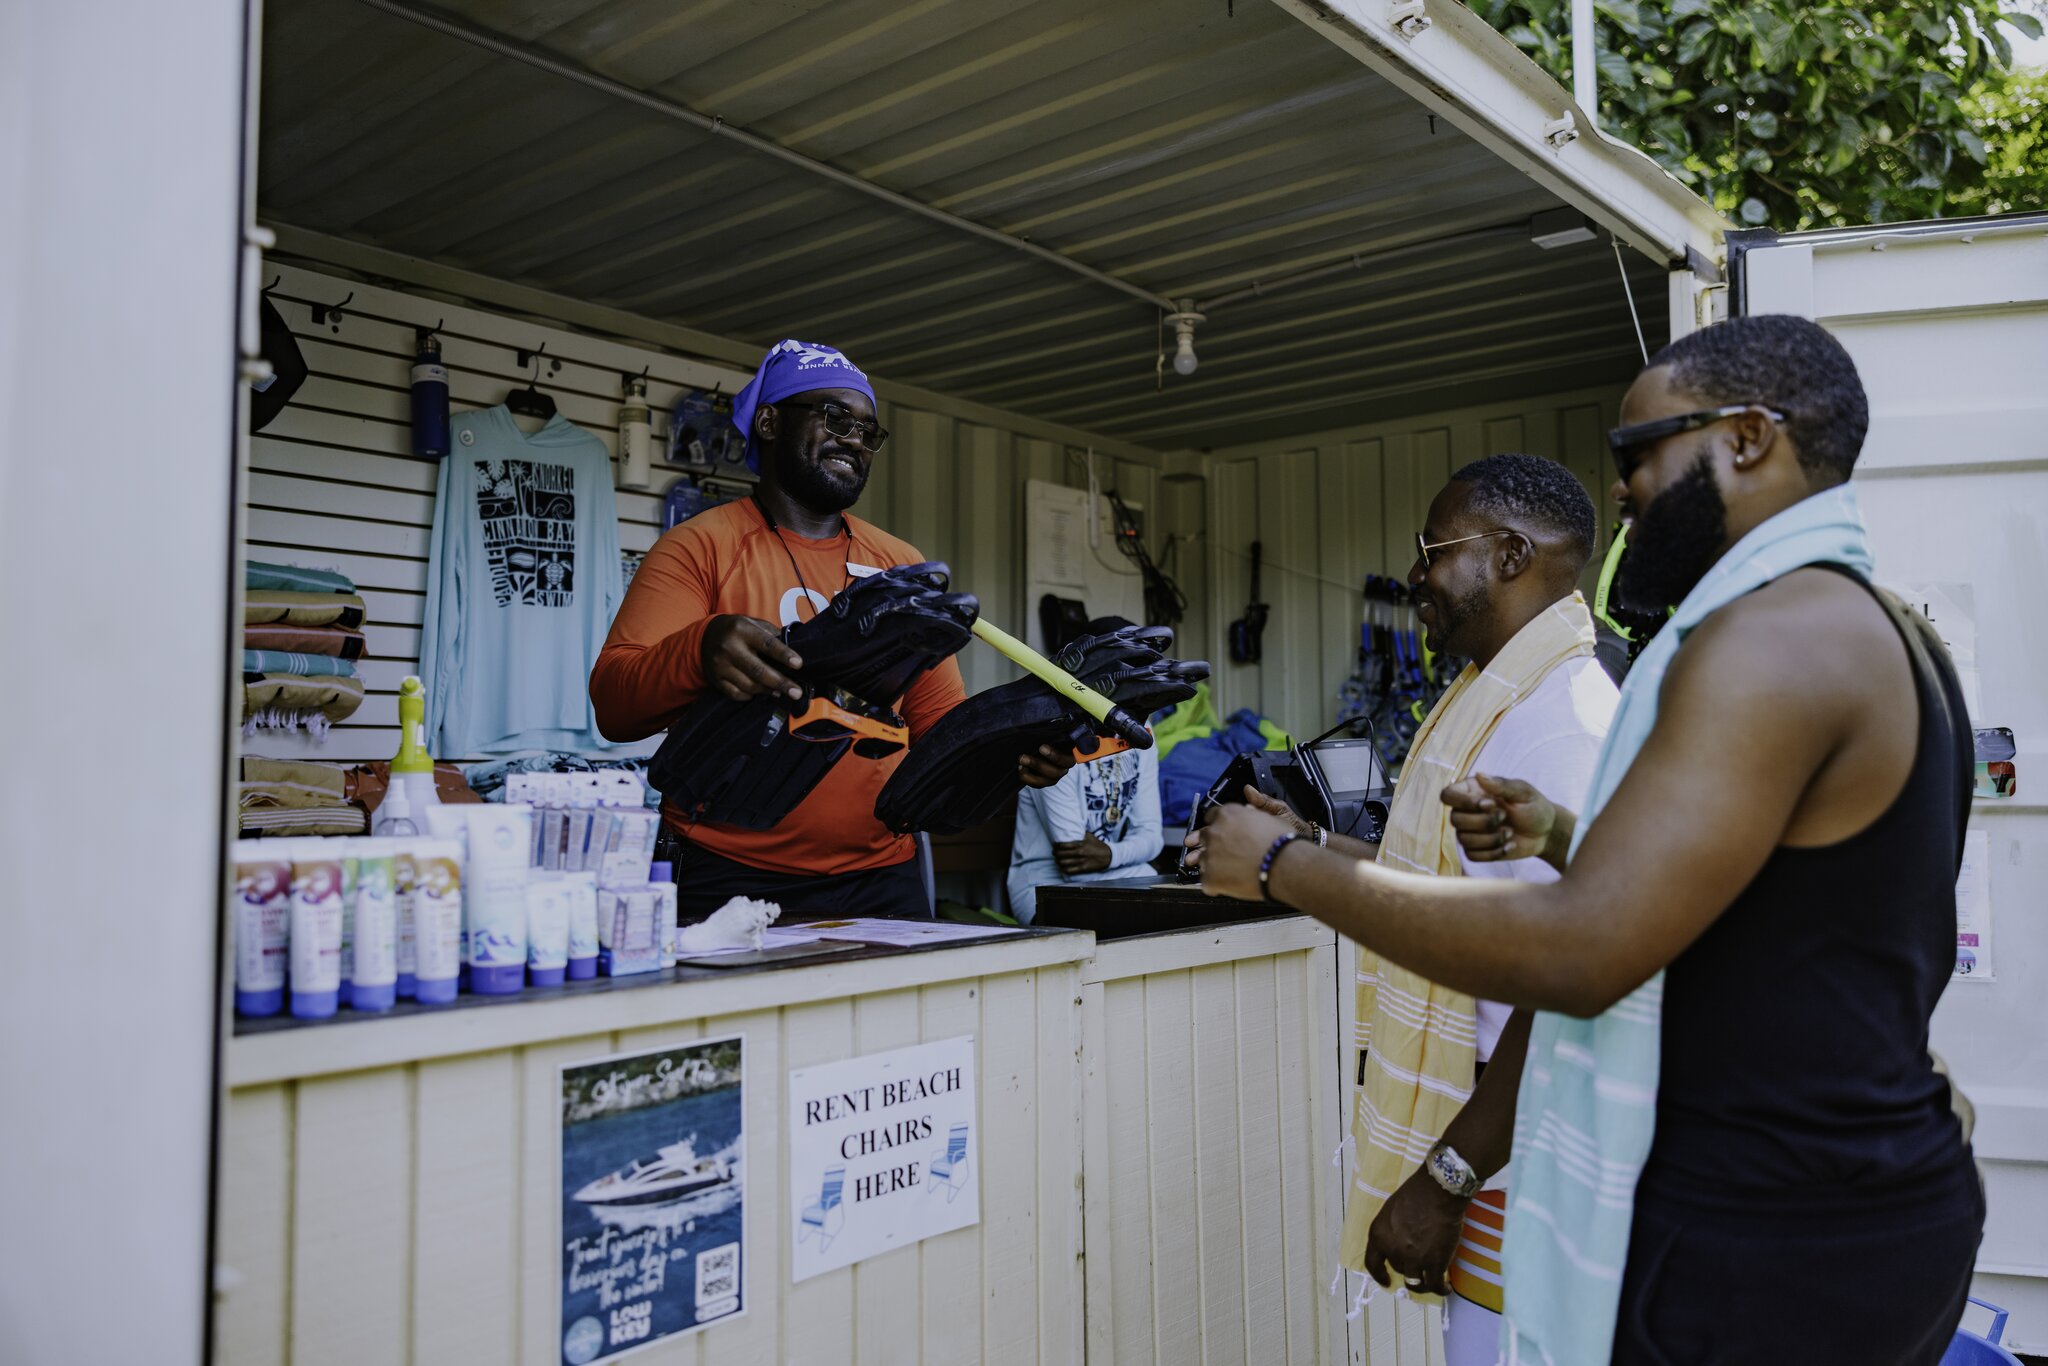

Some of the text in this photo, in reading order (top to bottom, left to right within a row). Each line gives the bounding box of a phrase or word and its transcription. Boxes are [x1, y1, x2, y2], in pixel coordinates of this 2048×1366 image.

[547, 521, 575, 542] BAY
[537, 591, 575, 608] SWIM
[805, 1067, 962, 1126] RENT BEACH
[840, 1115, 932, 1160] CHAIRS
[855, 1161, 921, 1203] HERE
[610, 1300, 652, 1326] LOW
[610, 1316, 652, 1346] KEY
